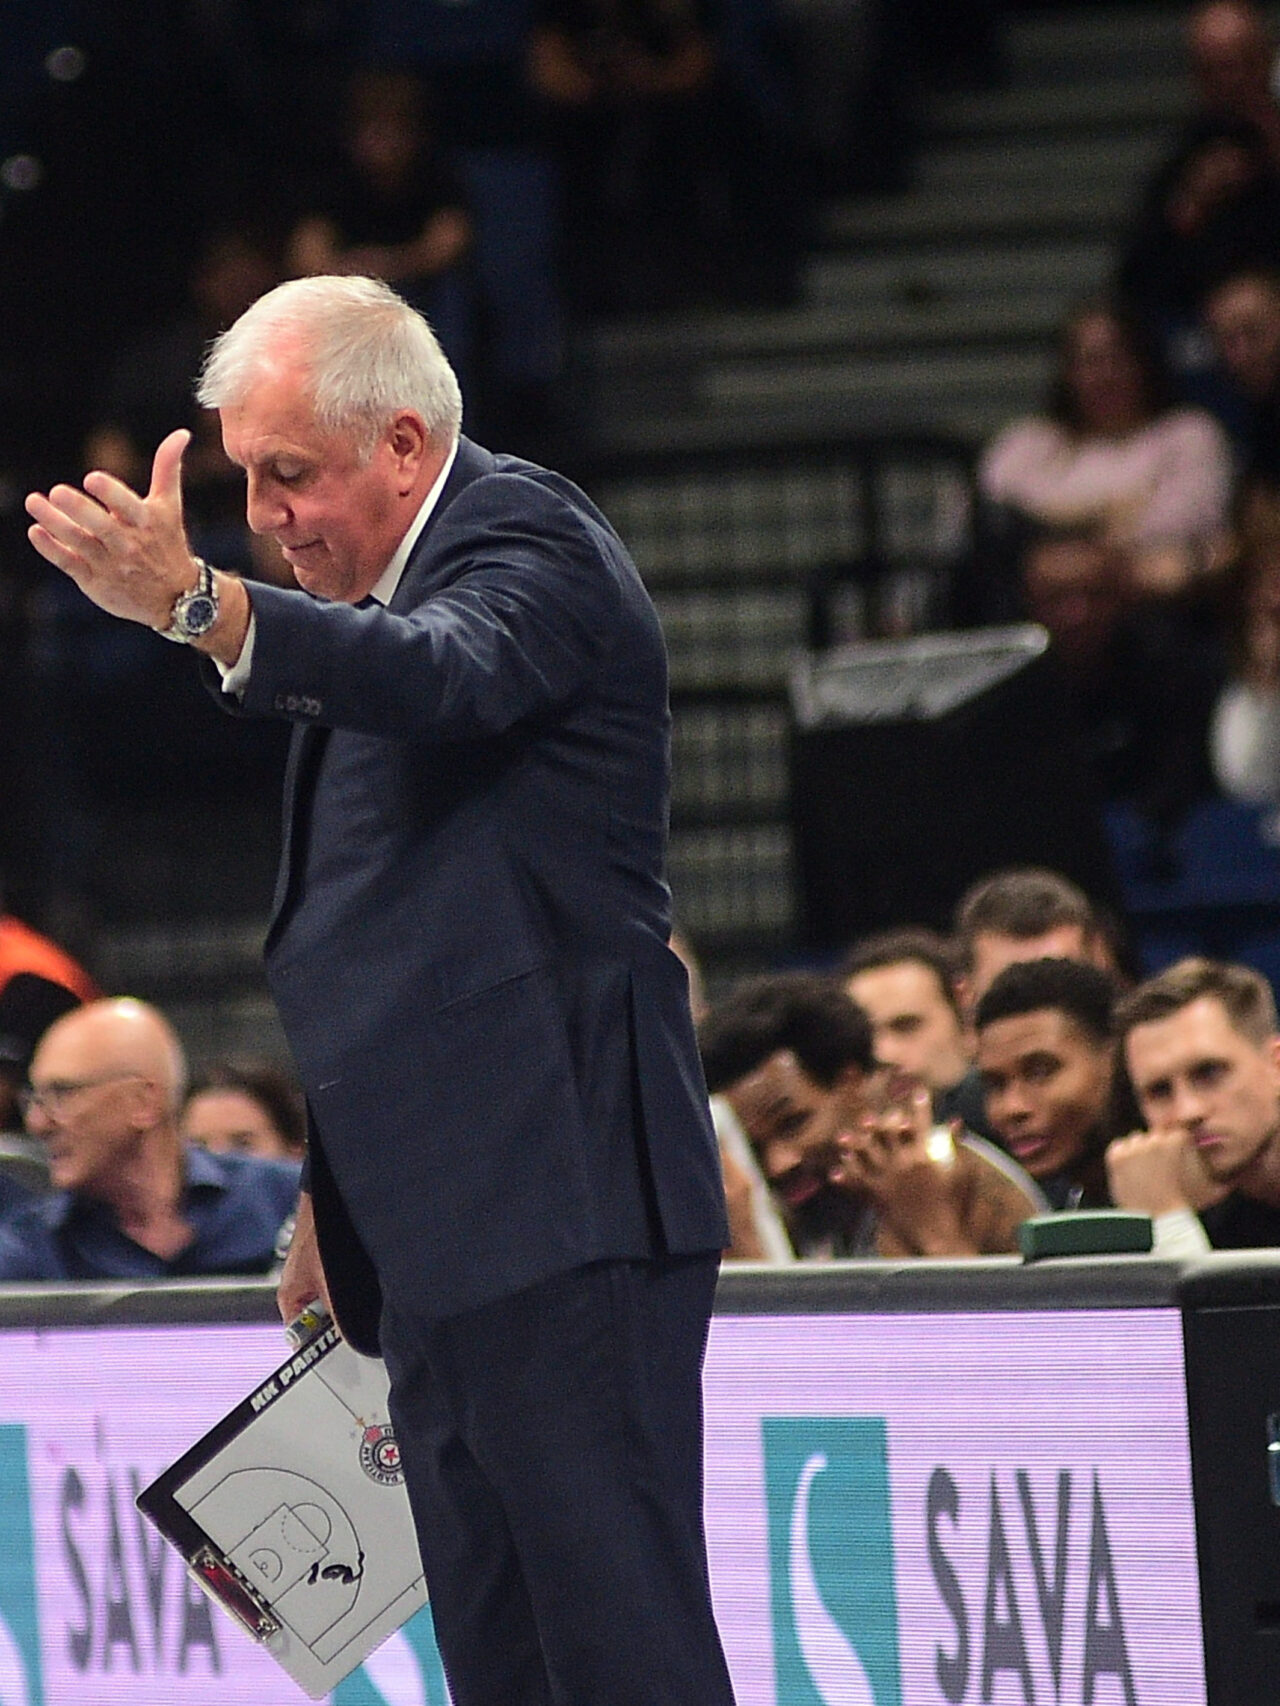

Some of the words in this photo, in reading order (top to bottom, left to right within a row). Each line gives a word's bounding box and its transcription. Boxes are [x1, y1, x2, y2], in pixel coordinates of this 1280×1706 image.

[250, 1381, 280, 1413] KK
[279, 1326, 340, 1386] PARTI
[59, 1464, 223, 1678] SAVA
[926, 1465, 1137, 1706] SAVA
